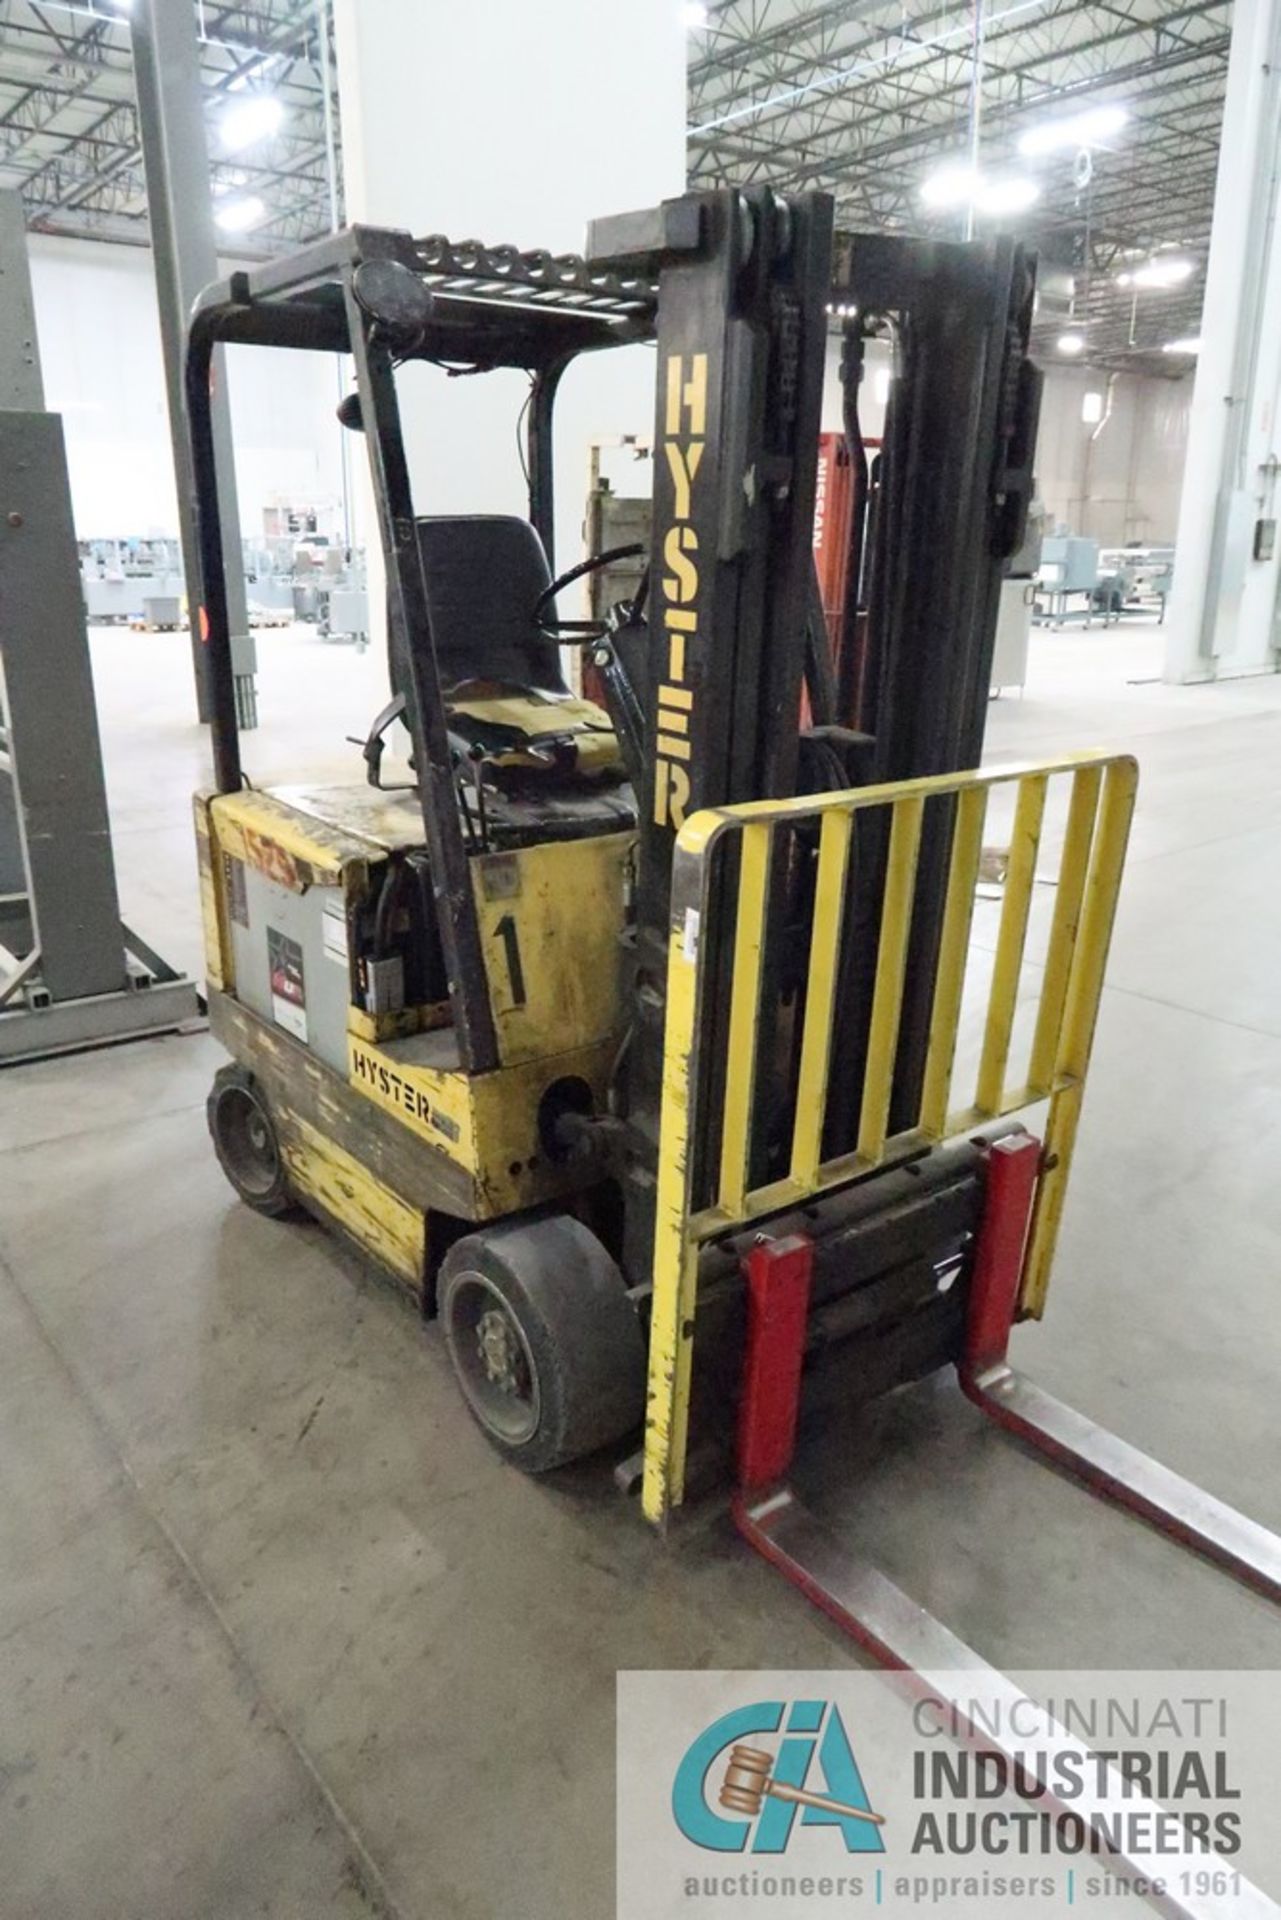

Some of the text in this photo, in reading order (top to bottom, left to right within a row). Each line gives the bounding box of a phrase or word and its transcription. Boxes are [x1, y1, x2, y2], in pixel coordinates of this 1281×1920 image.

[812, 457, 828, 549] NISSAN
[653, 353, 708, 832] HYSTER
[492, 915, 526, 1005] 1
[353, 1049, 430, 1124] HYSTER
